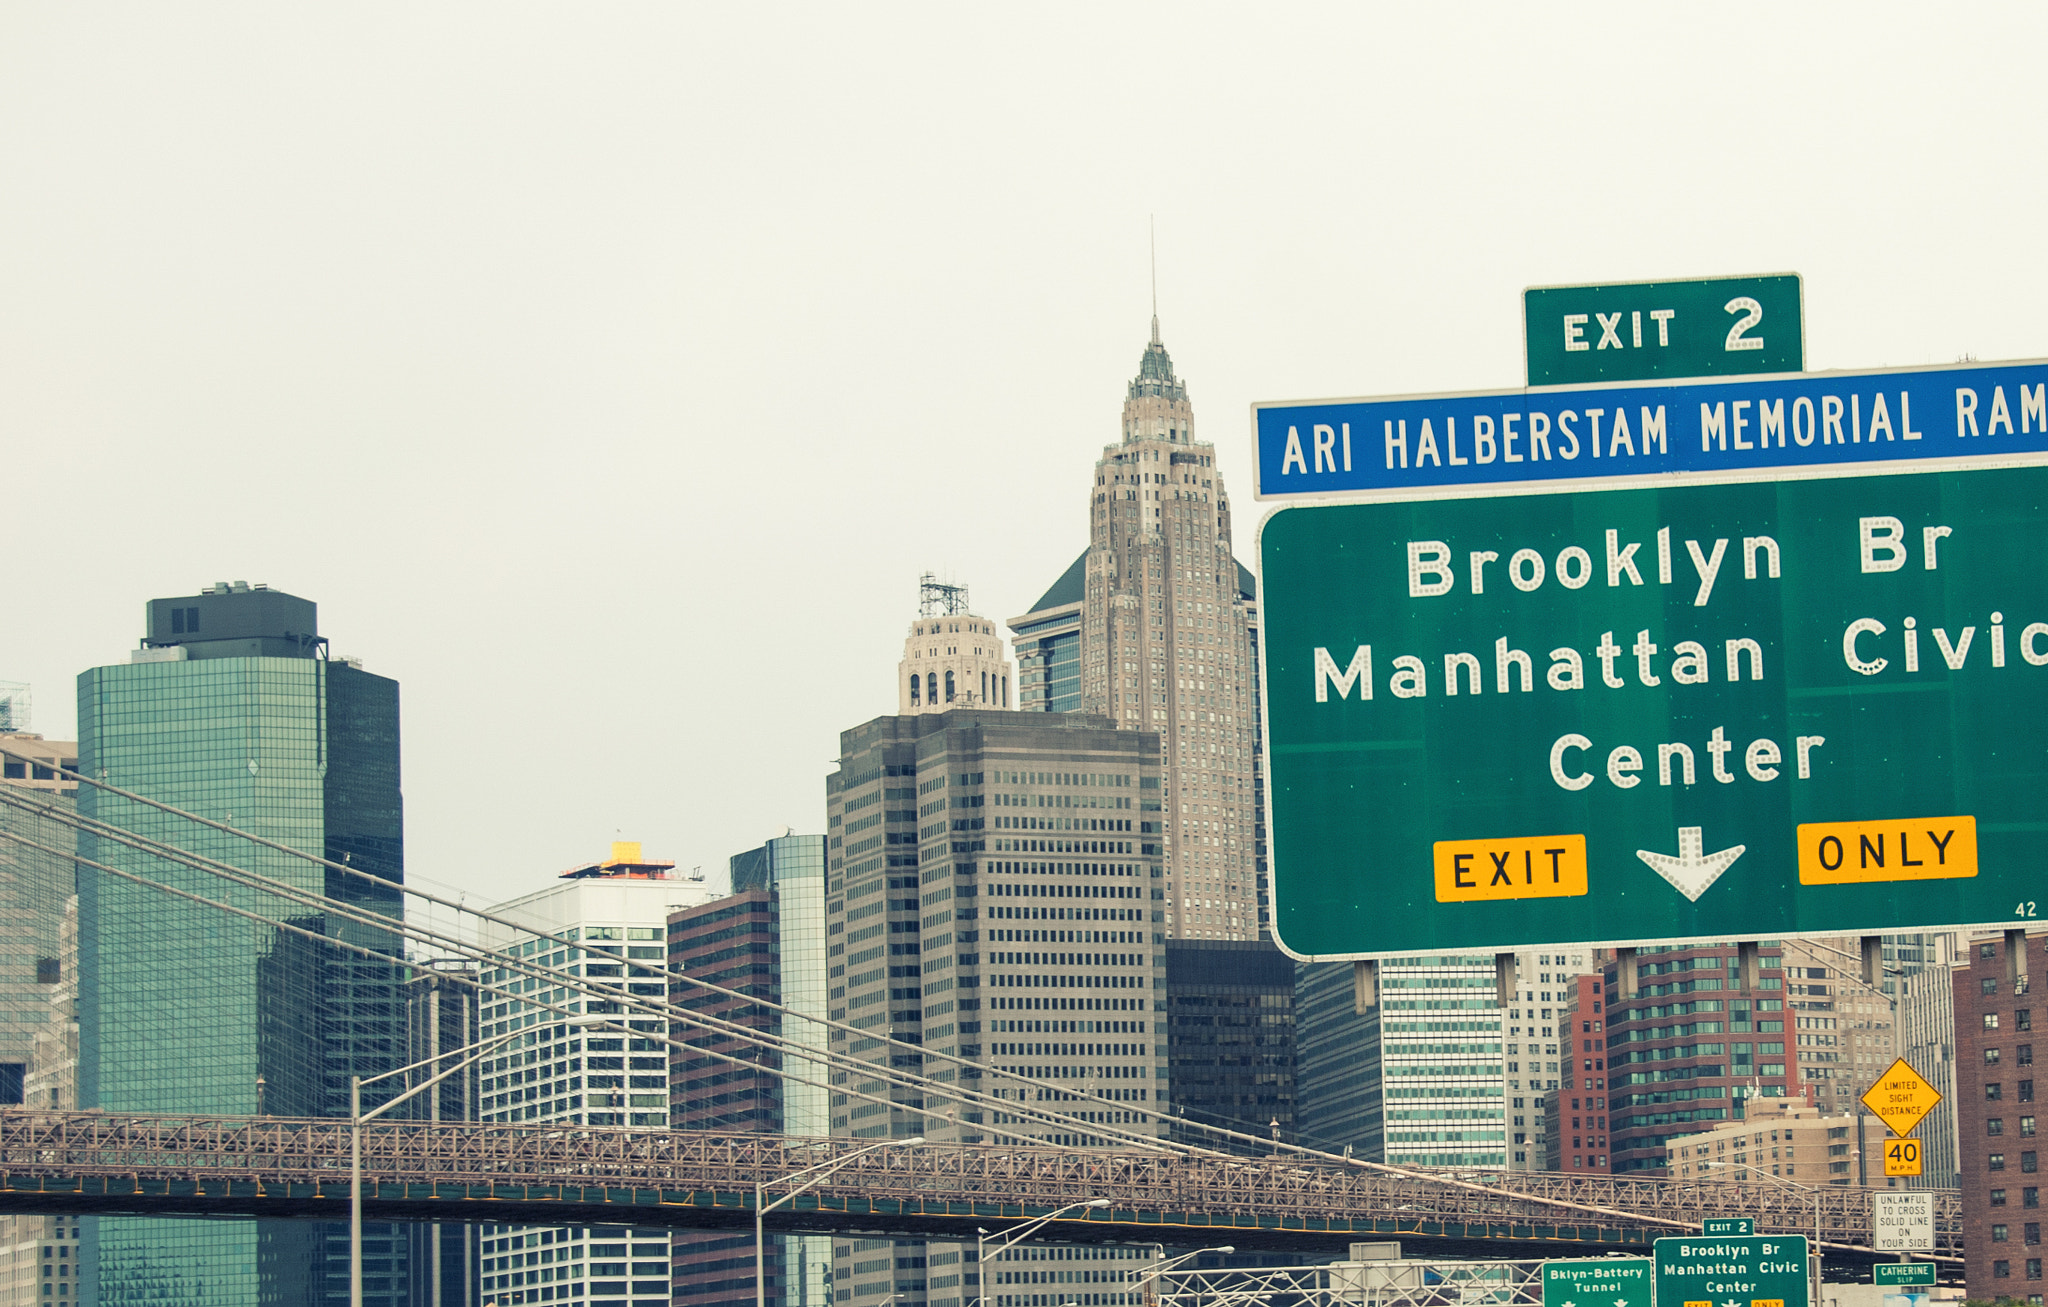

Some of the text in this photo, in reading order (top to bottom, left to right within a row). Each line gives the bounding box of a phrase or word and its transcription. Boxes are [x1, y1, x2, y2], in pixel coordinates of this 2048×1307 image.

[1563, 296, 1765, 353] EXIT 2
[1281, 382, 2048, 475] ARI HALBERSTAM MEMORIAL RAM
[1406, 515, 1954, 607] Brooklyn Br
[1313, 611, 2048, 704] Manhattan Civic
[1549, 725, 1827, 792] Center
[1818, 829, 1956, 872] ONLY
[1453, 848, 1567, 888] EXIT
[2015, 901, 2037, 917] 42
[1884, 1081, 1918, 1090] LIMITED
[1889, 1094, 1913, 1103] SIGHT
[1881, 1106, 1922, 1116] DISTANCE
[1888, 1143, 1917, 1162] 40
[1880, 1195, 1927, 1205] UNLAWFUL
[1883, 1206, 1926, 1215] TO CROSS
[1709, 1221, 1748, 1233] EXIT 2
[1880, 1216, 1929, 1226] SOLID LINE
[1898, 1228, 1911, 1236] ON
[1881, 1238, 1928, 1247] YOUR SIDE
[1680, 1243, 1780, 1260] Brooklyn Br
[1550, 1268, 1643, 1281] Bklyn-Battery
[1664, 1261, 1799, 1276] Manhattan Civic
[1881, 1265, 1929, 1276] CATHERINE
[1574, 1282, 1621, 1293] Tunnel
[1706, 1281, 1757, 1293] Center
